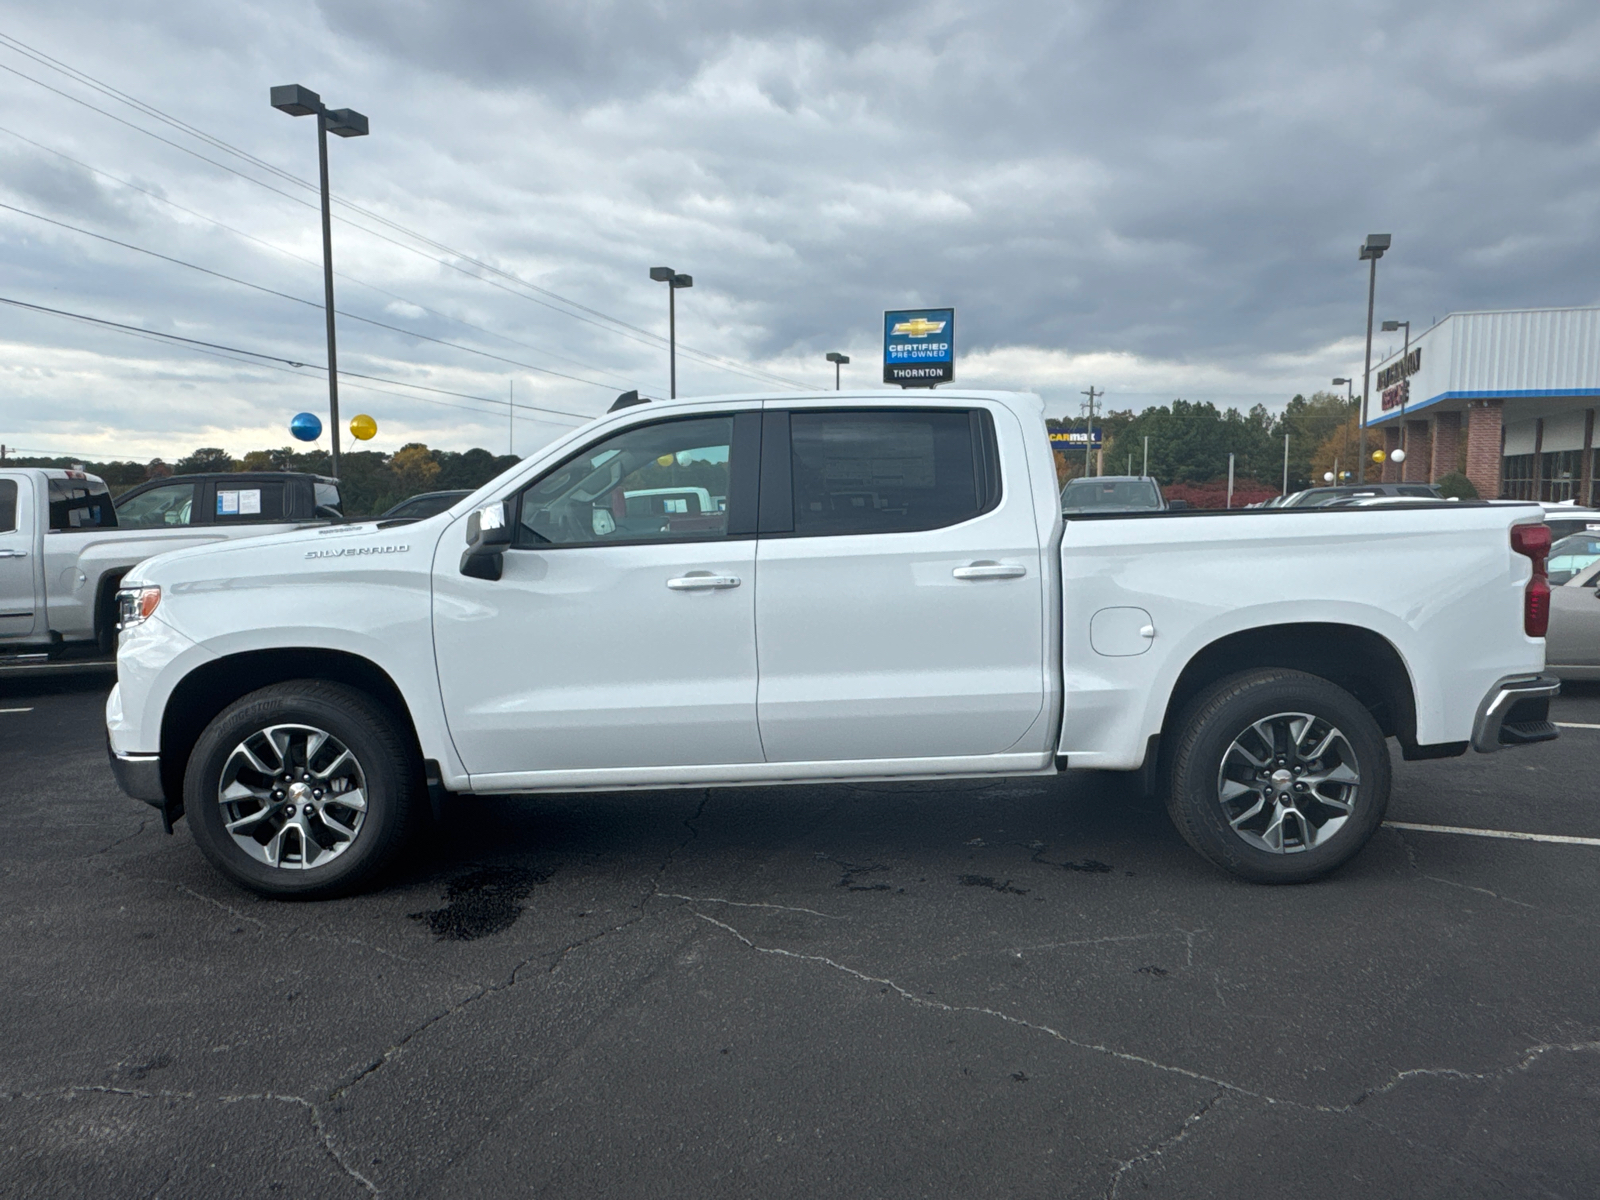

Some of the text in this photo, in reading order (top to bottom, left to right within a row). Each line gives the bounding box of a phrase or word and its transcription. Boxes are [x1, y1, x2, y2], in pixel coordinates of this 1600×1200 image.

[889, 343, 948, 352] CERTIFIED
[891, 350, 945, 358] PRE-OWNED
[893, 368, 943, 378] THORNTON
[304, 544, 410, 559] SILVERADO
